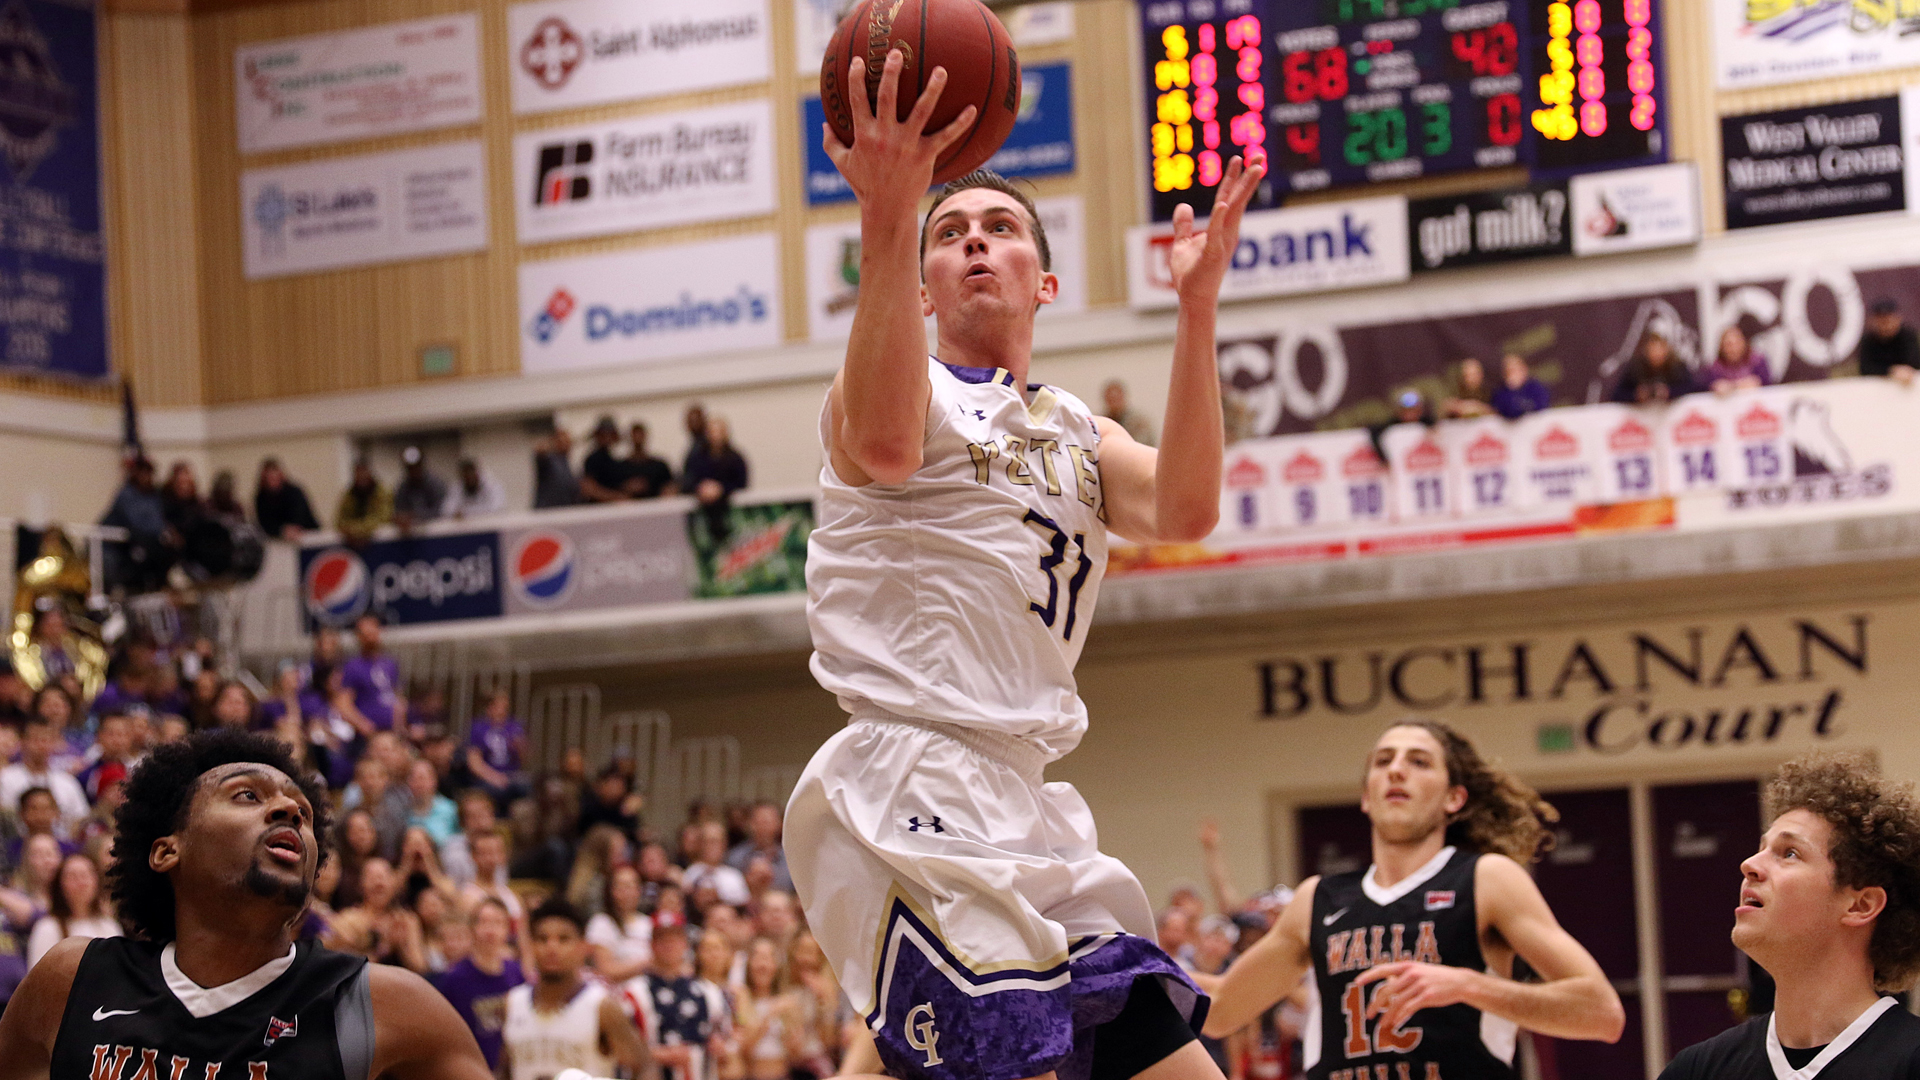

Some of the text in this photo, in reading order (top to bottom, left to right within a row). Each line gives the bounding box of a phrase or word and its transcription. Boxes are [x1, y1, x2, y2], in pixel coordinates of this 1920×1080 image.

[1282, 47, 1348, 103] 68
[1286, 122, 1320, 164] 4
[1344, 108, 1408, 165] 20
[1422, 102, 1452, 155] 3
[1487, 93, 1523, 146] 0
[1419, 203, 1470, 268] got
[1475, 189, 1566, 250] milk?
[583, 284, 767, 342] Domino's
[1473, 470, 1506, 505] 12
[1615, 458, 1652, 491] 13
[1681, 449, 1717, 483] 14
[1744, 443, 1780, 477] 15
[1413, 477, 1443, 511] 11
[372, 545, 494, 613] pepsi
[1023, 505, 1093, 645] 31
[1255, 614, 1874, 721] BUCHANAN
[1580, 688, 1847, 756] Court
[1326, 920, 1442, 976] WALLA
[1341, 979, 1424, 1060] 12
